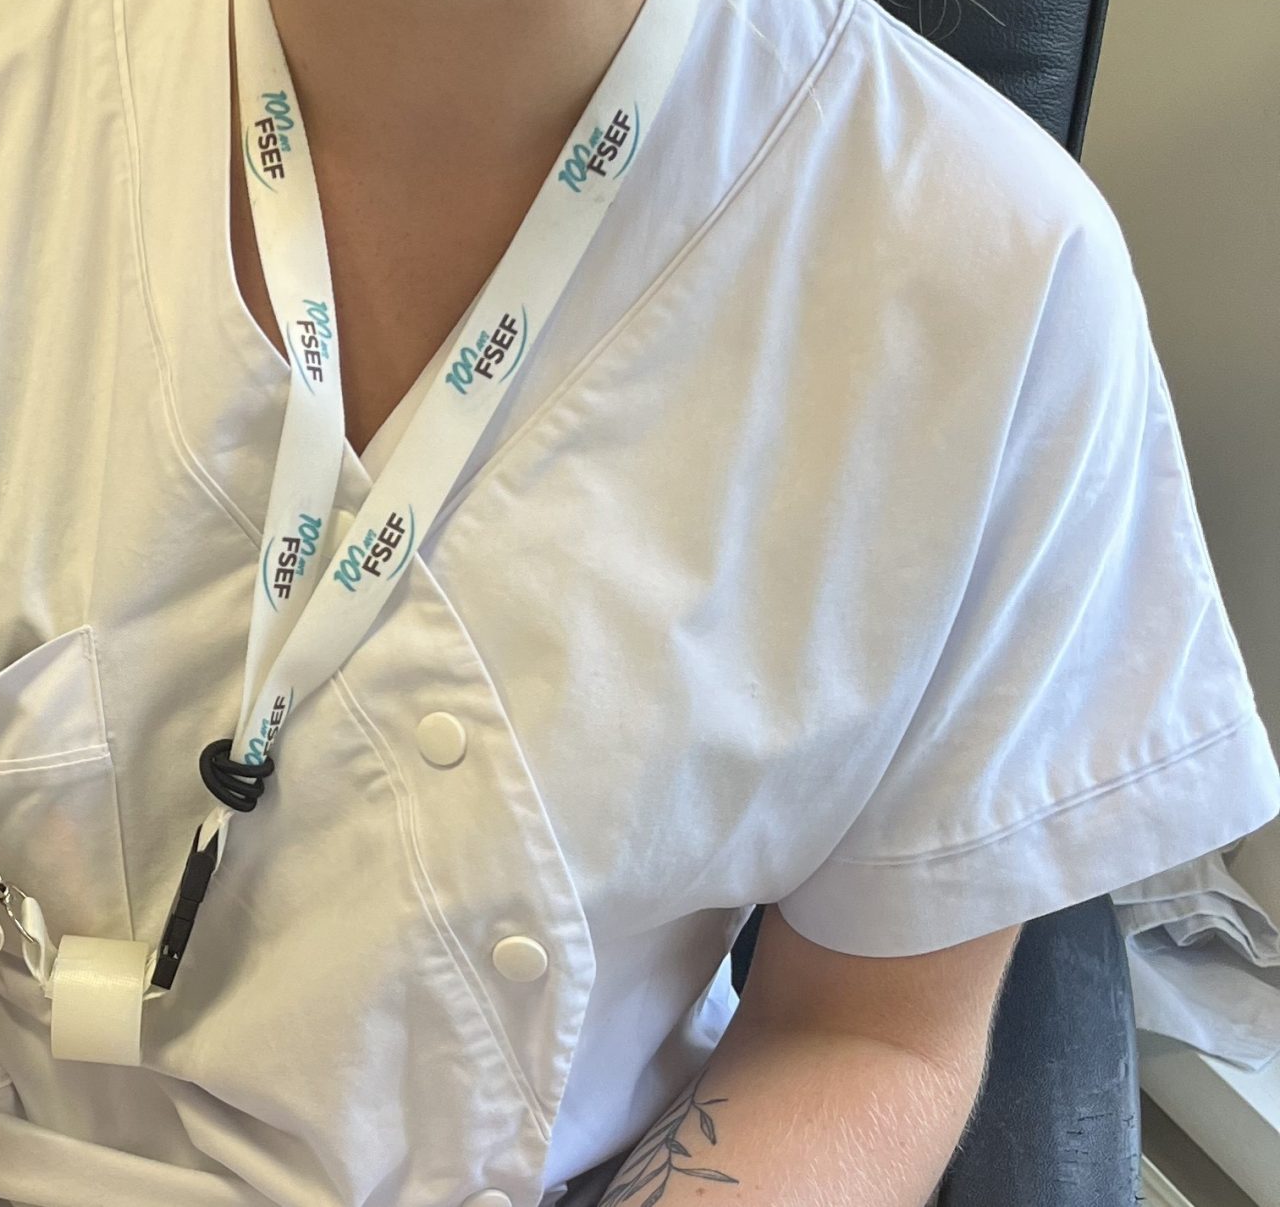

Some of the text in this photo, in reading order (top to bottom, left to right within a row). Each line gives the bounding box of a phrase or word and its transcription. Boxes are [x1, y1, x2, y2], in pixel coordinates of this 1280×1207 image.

[261, 90, 295, 132] 100
[254, 117, 286, 181] FSEF
[558, 143, 592, 193] 100
[586, 108, 632, 178] FSEF
[302, 299, 332, 343] 100
[474, 312, 519, 380] FSEF
[296, 319, 324, 383] FSEF
[445, 346, 478, 396] 100
[297, 513, 322, 557] 100
[361, 511, 407, 579] FSEF
[273, 535, 301, 600] FSEF
[333, 544, 366, 593] 100
[244, 737, 266, 766] 00
